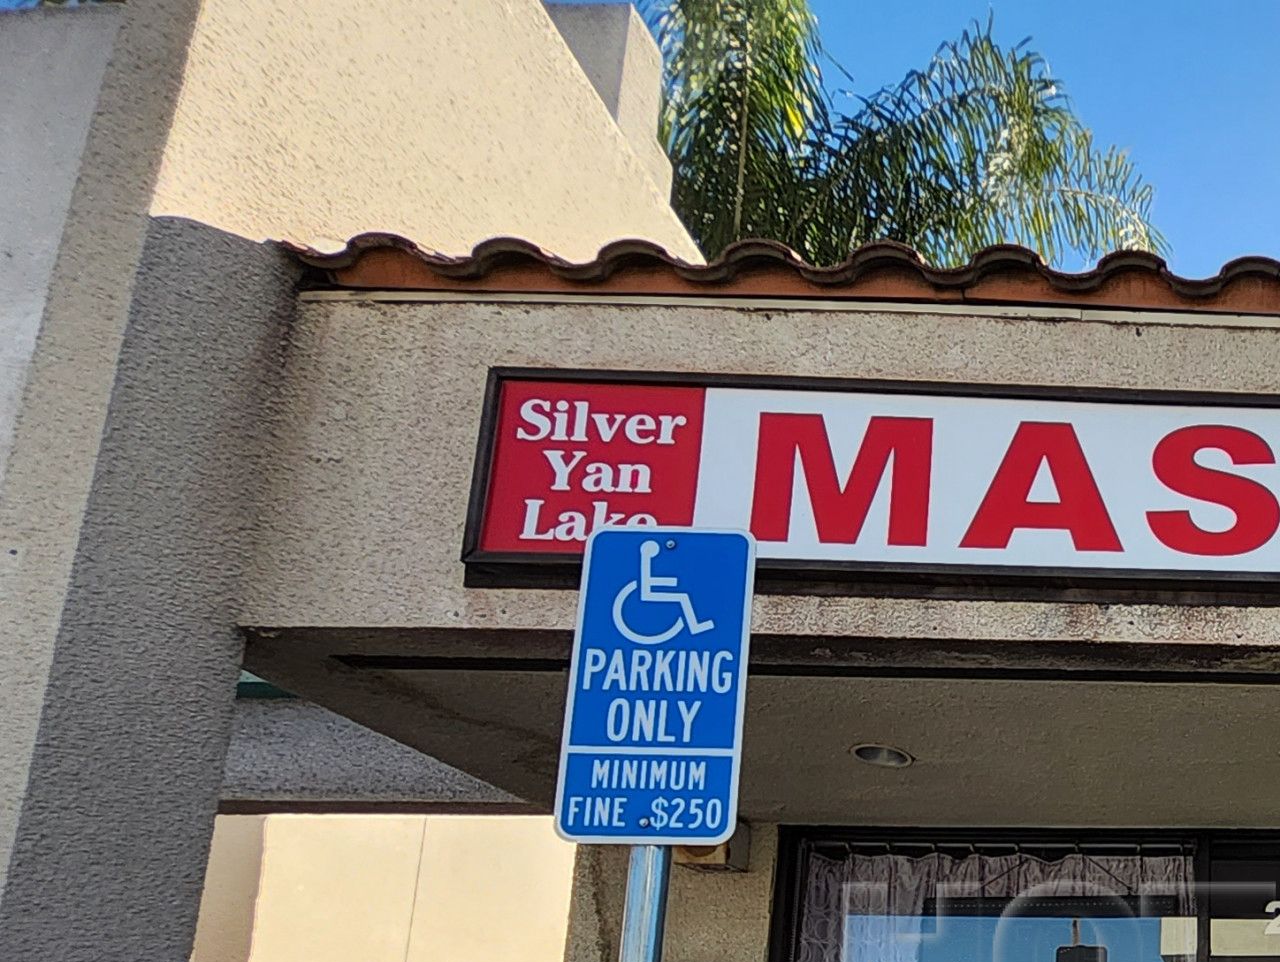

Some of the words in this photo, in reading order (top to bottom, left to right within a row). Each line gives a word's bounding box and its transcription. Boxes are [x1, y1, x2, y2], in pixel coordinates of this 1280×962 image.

[516, 399, 687, 444] Silver
[543, 450, 652, 494] Yan
[582, 648, 733, 694] PARKING
[607, 698, 701, 743] ONLY
[591, 759, 706, 790] MINIMUM
[567, 797, 627, 826] FINE
[650, 796, 722, 830] $250
